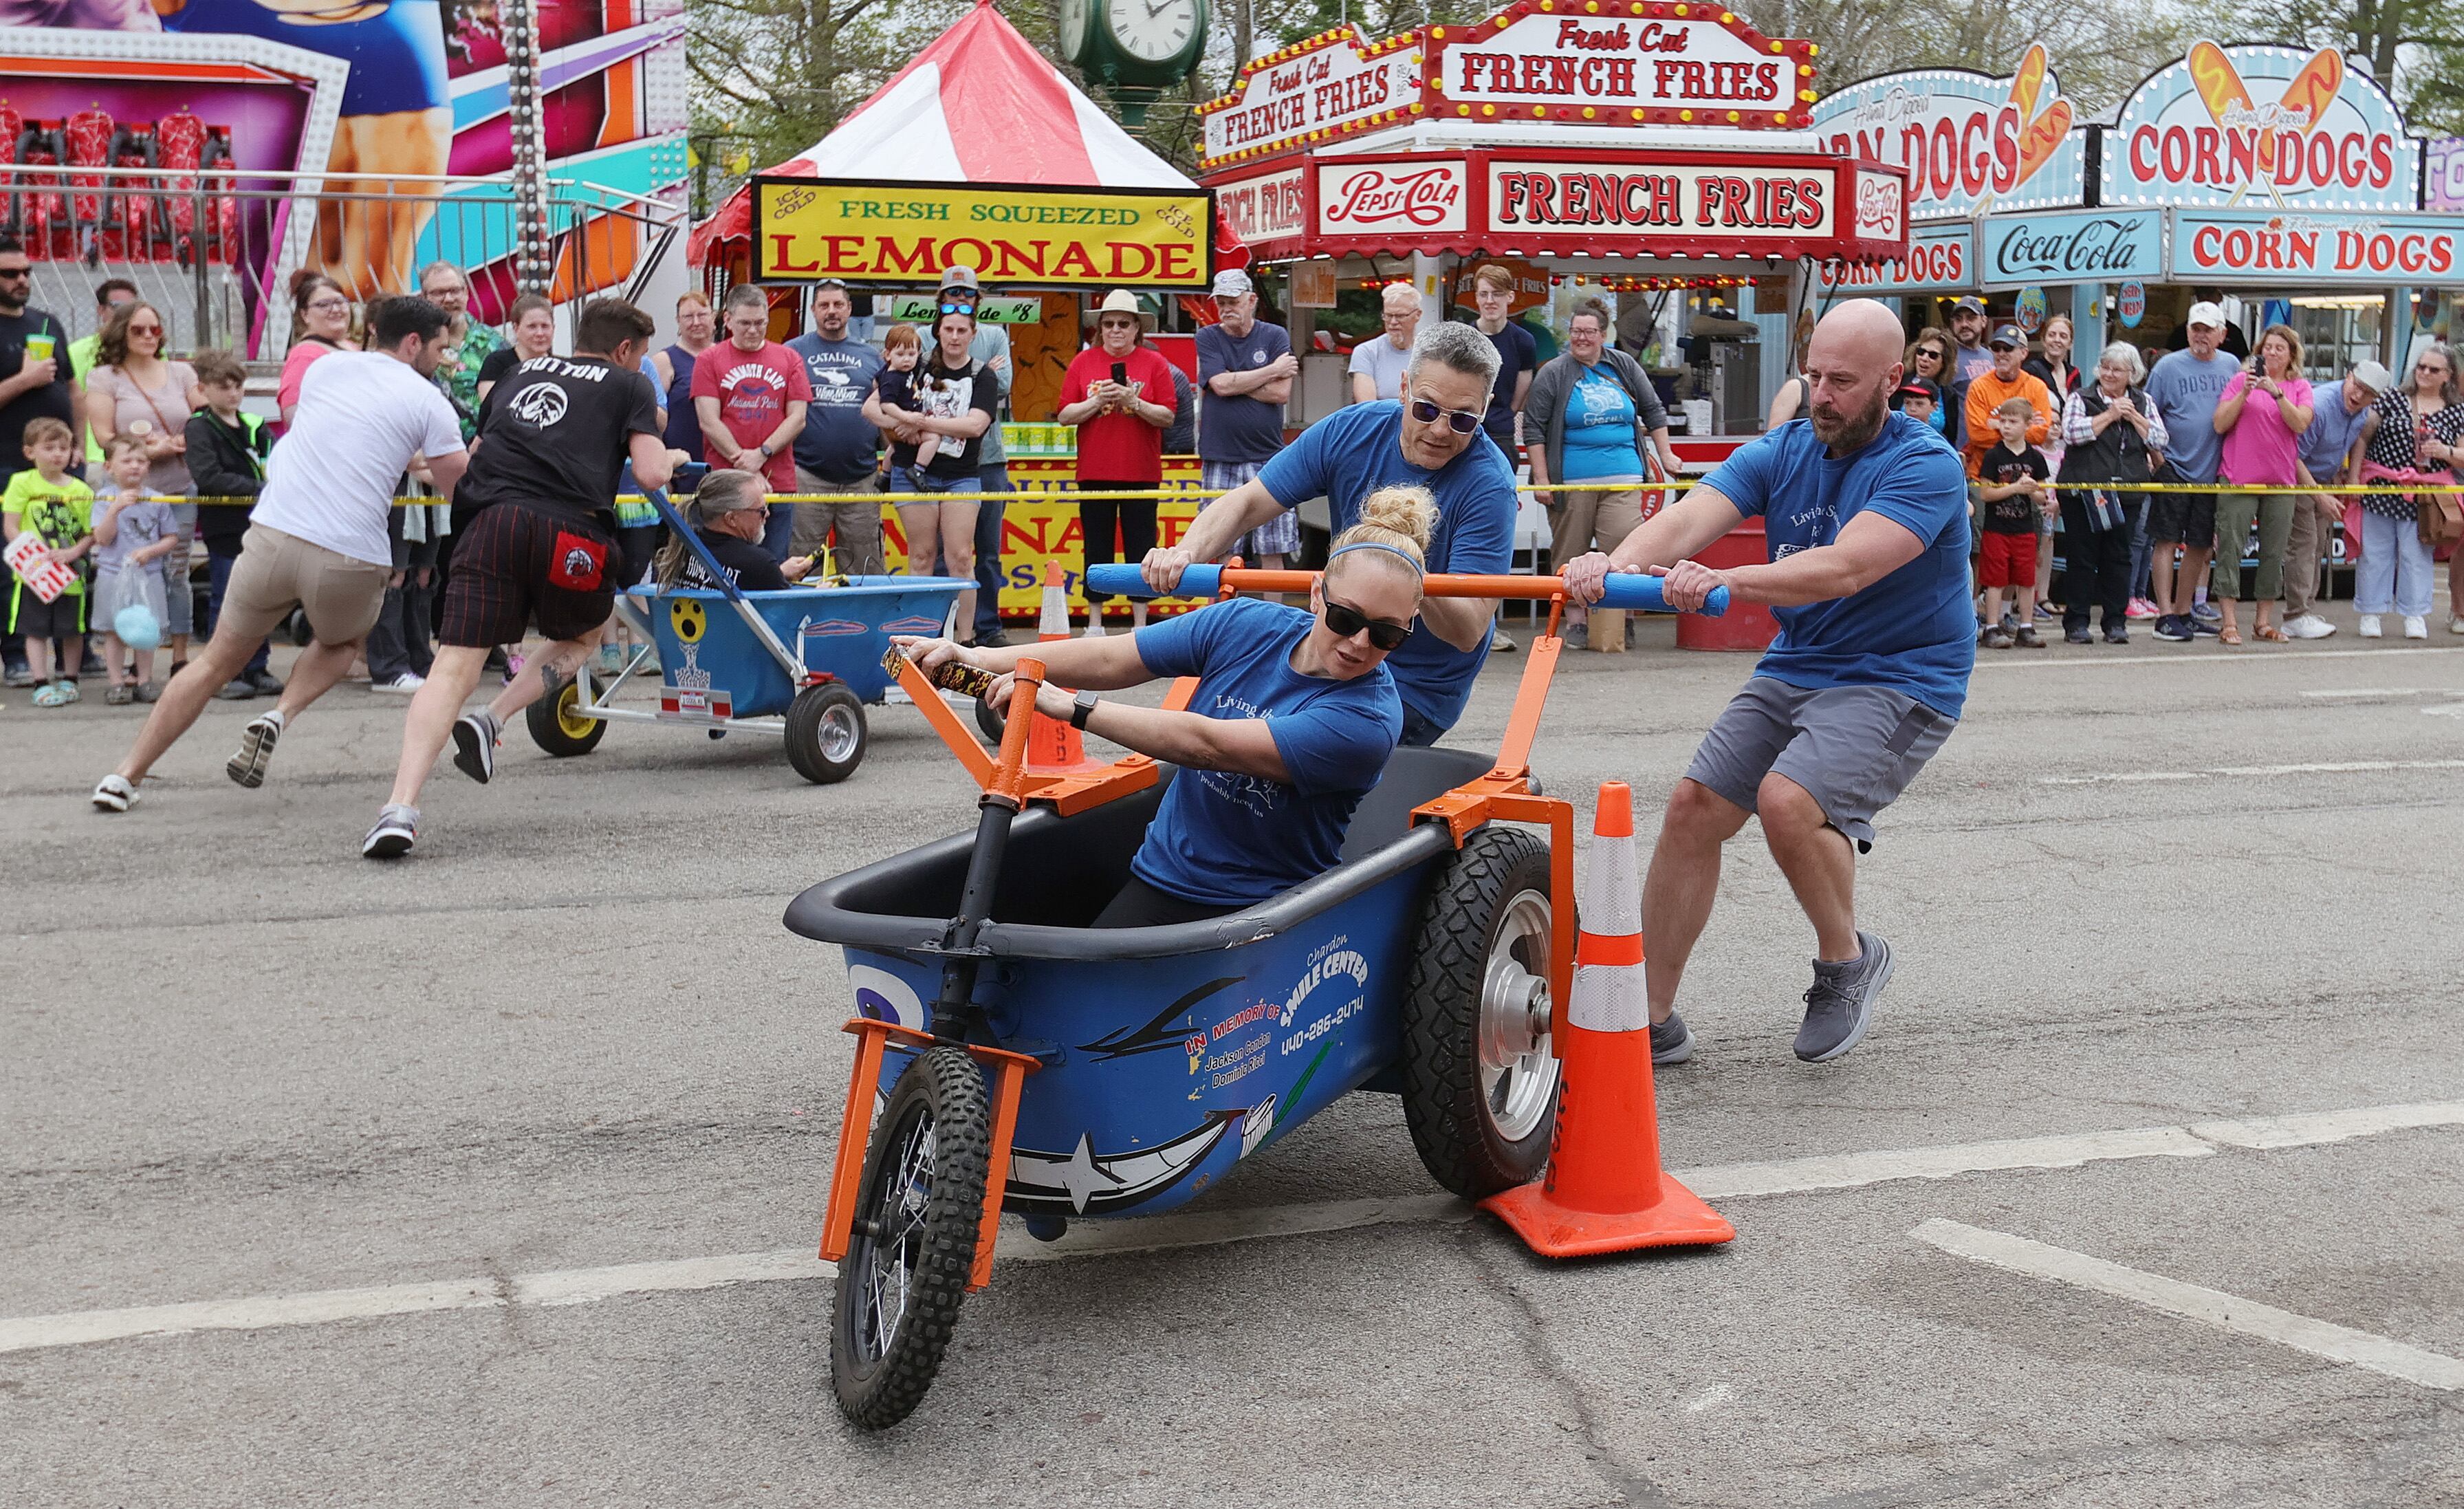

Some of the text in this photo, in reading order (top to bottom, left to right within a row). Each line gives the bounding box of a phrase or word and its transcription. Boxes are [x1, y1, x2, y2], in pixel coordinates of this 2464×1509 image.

[1557, 19, 1689, 53] Fresh Cut
[1269, 54, 1331, 96] Fresh Cut
[1460, 52, 1637, 97] FRENCH
[1653, 58, 1779, 102] FRIES
[1225, 91, 1305, 147] FRENCH
[1314, 63, 1390, 122] FRIES
[1901, 107, 2018, 202] DOGS
[2130, 124, 2394, 190] CORN DOGS
[774, 192, 816, 219] COLD
[776, 186, 804, 206] ICE
[840, 201, 1140, 226] FRESH SQUEEZED
[1168, 205, 1193, 225] ICE
[1498, 171, 1823, 228] FRENCH FRIES
[1156, 209, 1195, 238] COLD
[770, 235, 1198, 279] LEMONADE
[1893, 243, 1963, 283] DOGS
[1998, 217, 2146, 274] Coca-Cola
[2192, 226, 2452, 273] CORN DOGS
[519, 358, 609, 383] SUTTON
[720, 363, 763, 391] MAMMOTH
[807, 351, 862, 368] CATALINA
[728, 395, 761, 408] National
[1216, 695, 1256, 719] Living
[1201, 774, 1264, 818] probably need us
[1307, 933, 1348, 967] Chardon
[1280, 950, 1369, 1028] SMILE CENTER
[1185, 1003, 1280, 1056] IN MEMORY OF
[1281, 995, 1364, 1057] 440-286-2474
[1205, 1047, 1244, 1072] Jackson
[1212, 1050, 1266, 1089] Dominic Ricci
